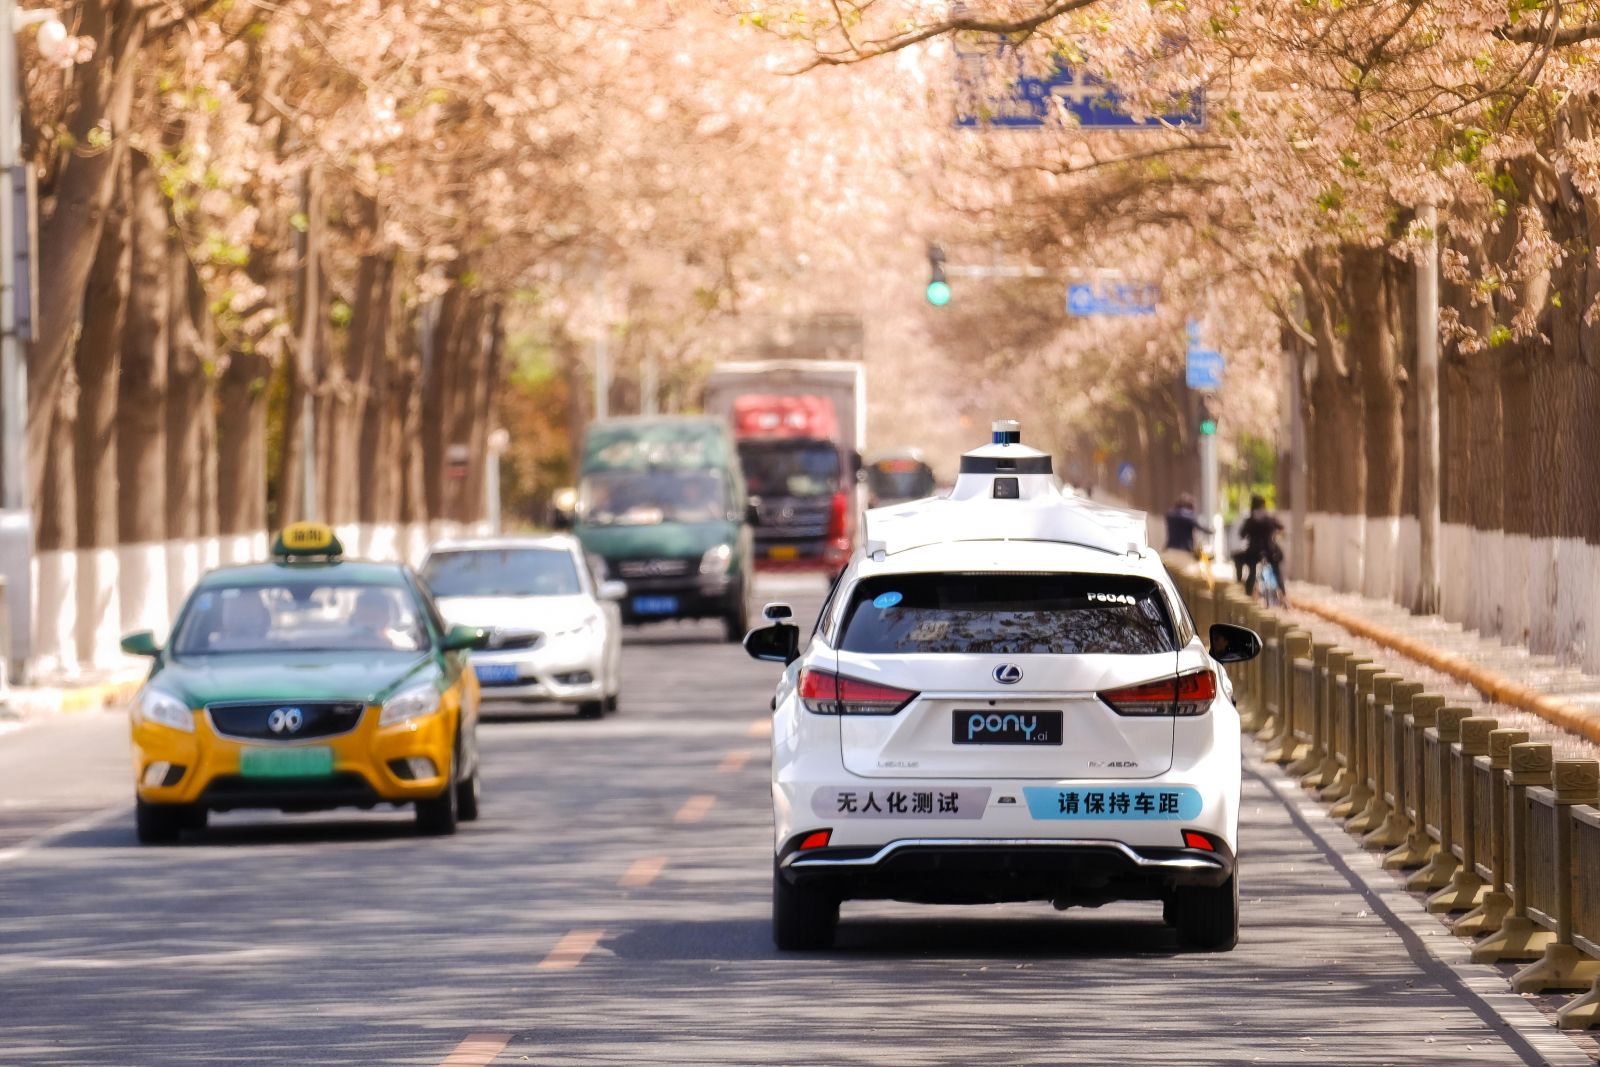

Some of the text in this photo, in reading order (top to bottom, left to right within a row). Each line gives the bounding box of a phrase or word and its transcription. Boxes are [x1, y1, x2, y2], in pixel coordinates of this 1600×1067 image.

[968, 714, 1048, 740] pony.ai
[837, 791, 959, 814] 无人化测试
[1058, 791, 1180, 814] 请保持车距
